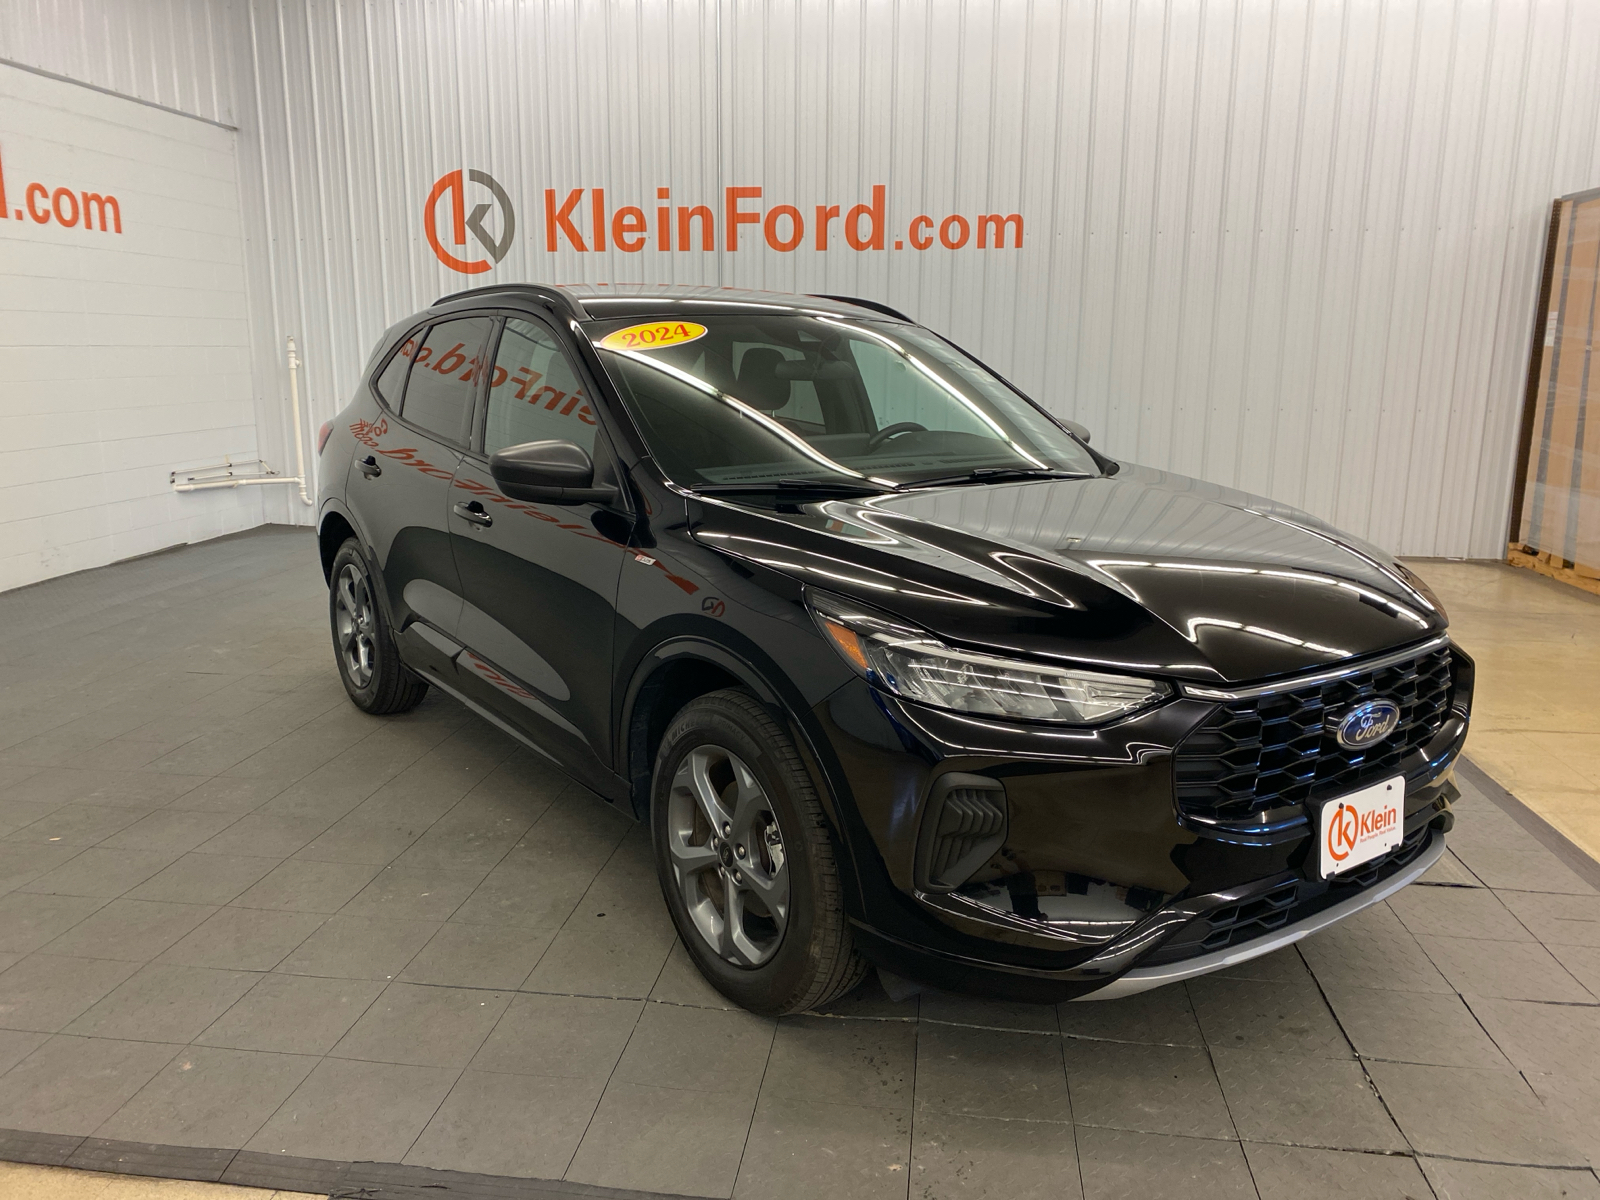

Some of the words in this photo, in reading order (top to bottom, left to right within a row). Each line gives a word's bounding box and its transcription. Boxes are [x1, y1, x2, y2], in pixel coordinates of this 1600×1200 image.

[0, 142, 122, 234] .com
[545, 185, 1024, 253] KleinFord.com
[621, 323, 690, 348] 2024
[1355, 713, 1390, 741] Ford
[1360, 804, 1396, 837] Klein
